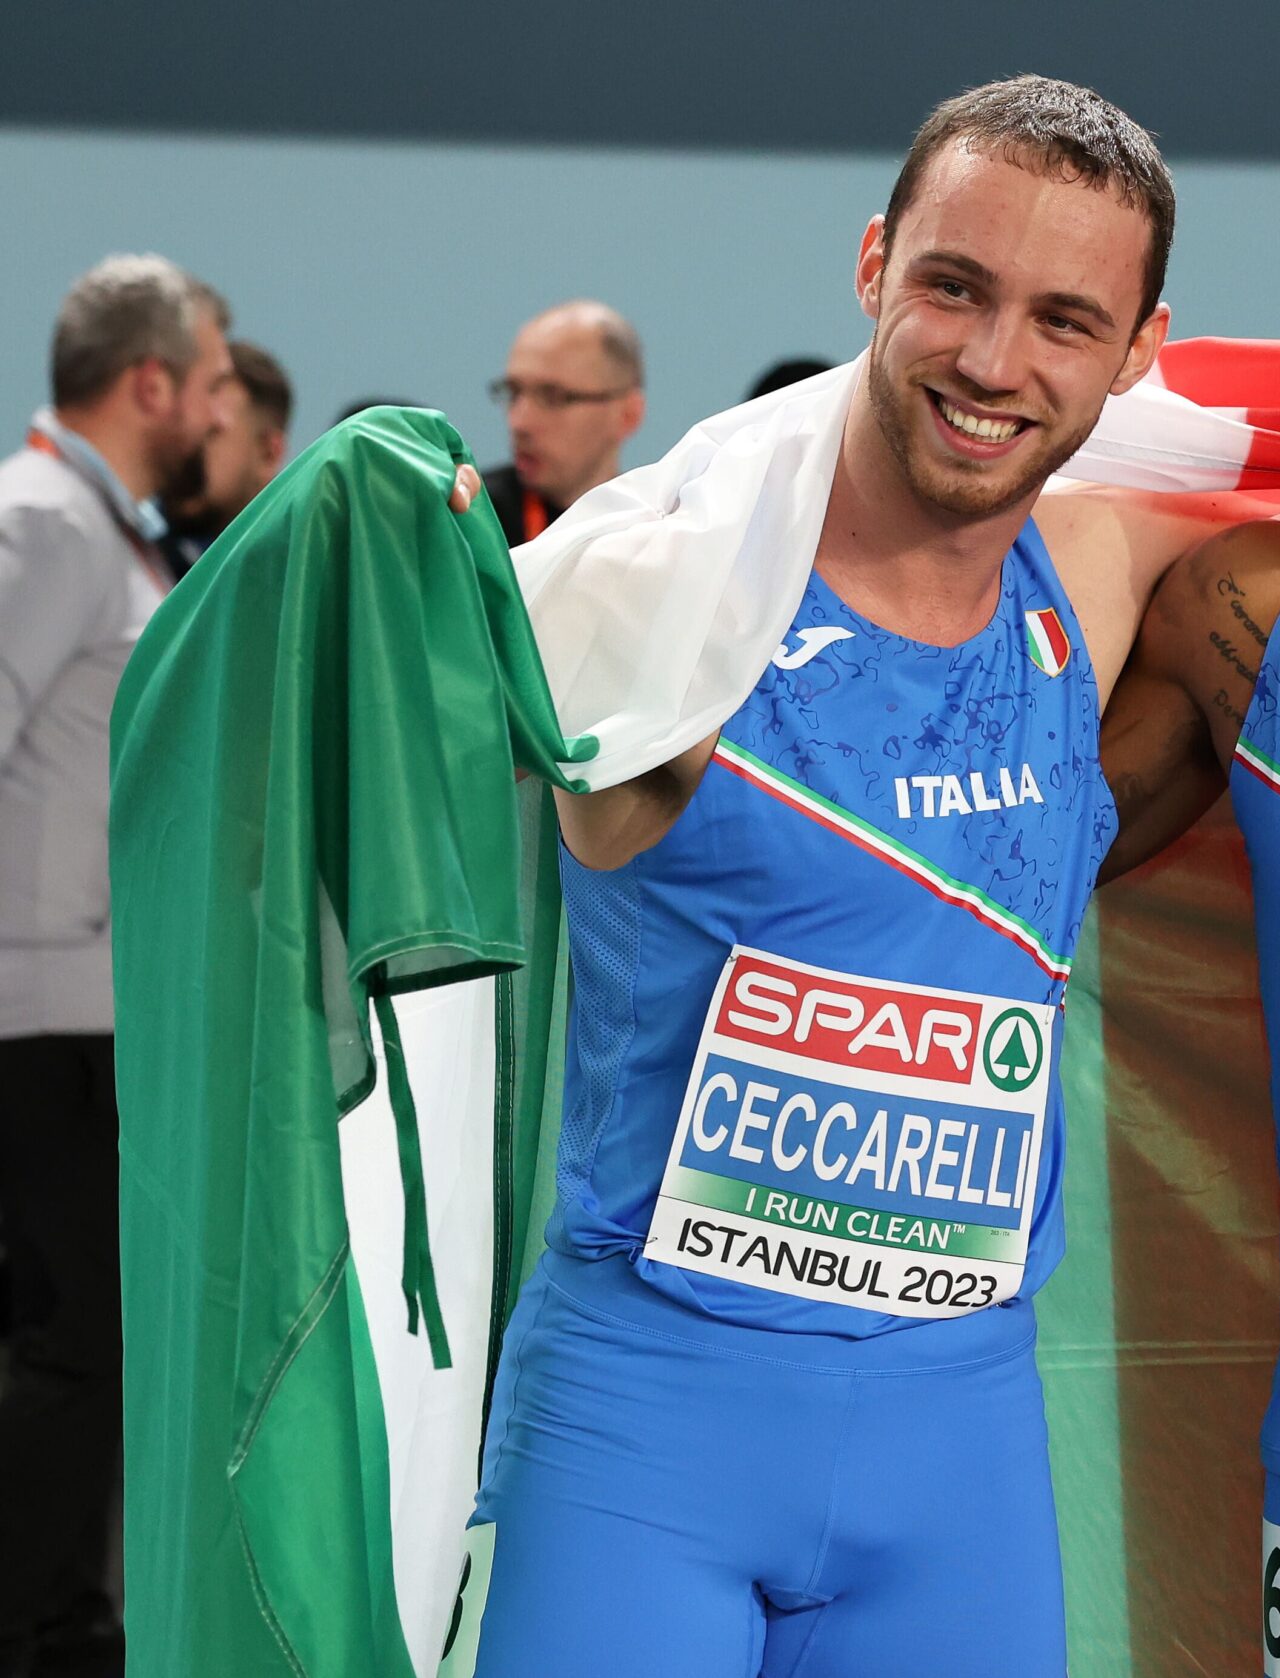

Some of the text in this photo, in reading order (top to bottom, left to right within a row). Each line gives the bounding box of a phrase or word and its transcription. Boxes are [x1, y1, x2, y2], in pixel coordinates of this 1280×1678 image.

[895, 763, 1044, 819] ITALIA
[728, 971, 973, 1071] SPAR
[692, 1072, 1031, 1209] CECCARELLI
[745, 1187, 757, 1212] I
[764, 1192, 839, 1231] RUN
[677, 1218, 998, 1308] ISTANBUL 2023
